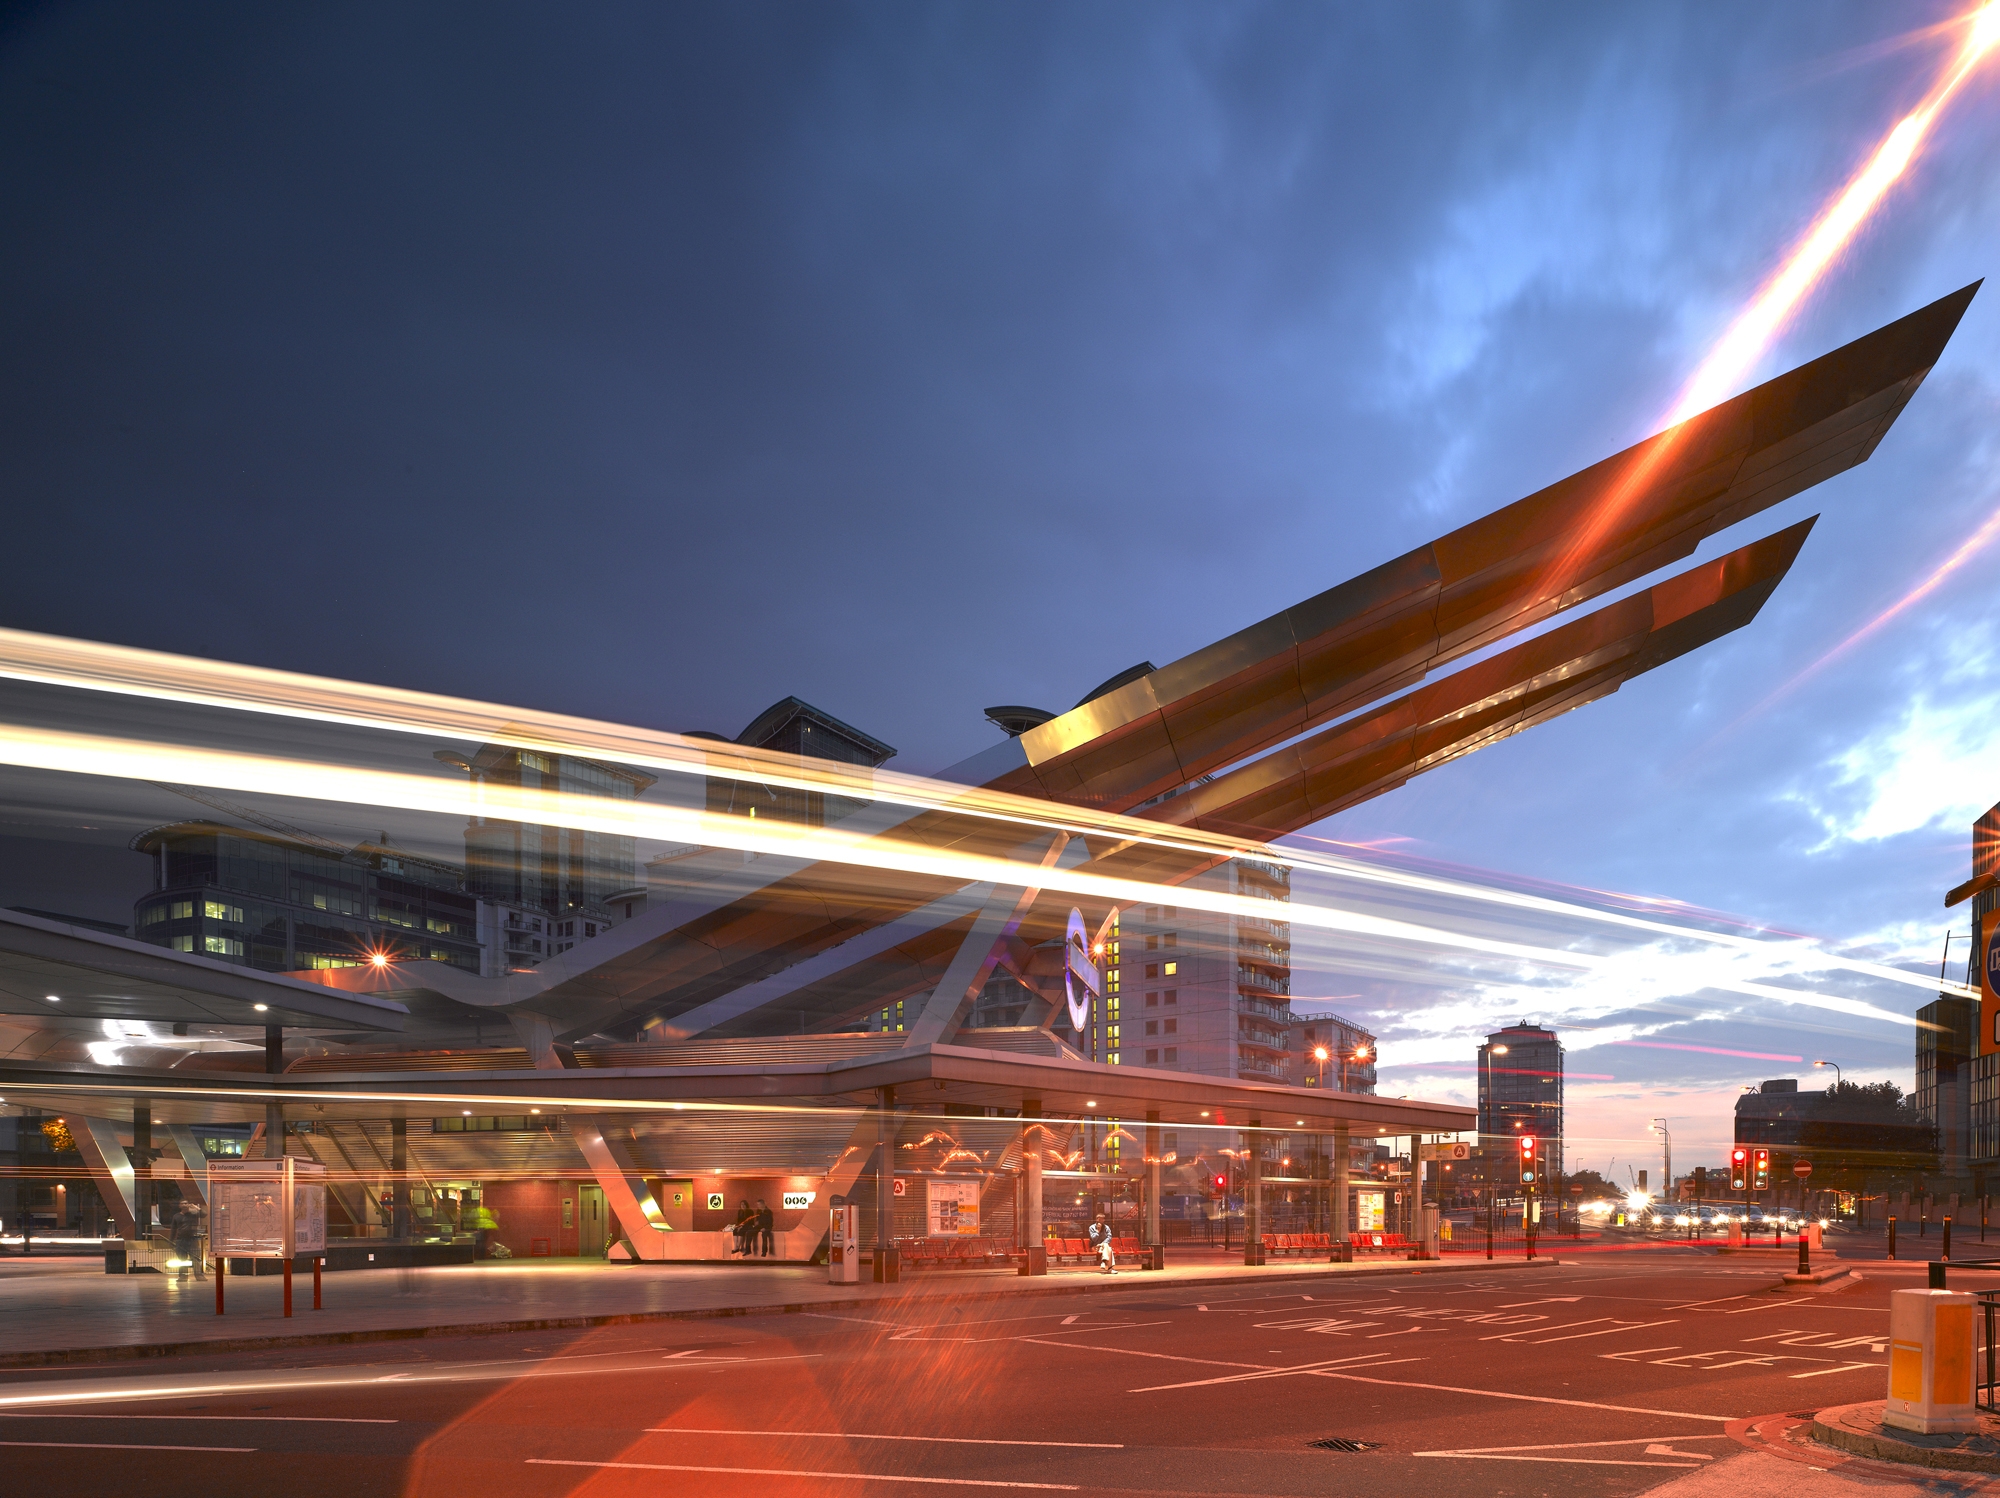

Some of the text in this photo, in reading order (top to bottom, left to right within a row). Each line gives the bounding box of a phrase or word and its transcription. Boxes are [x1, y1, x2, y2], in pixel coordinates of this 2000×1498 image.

[1456, 1147, 1463, 1156] A
[894, 1183, 901, 1192] A
[1339, 1306, 1550, 1325] AHEAD
[1252, 1317, 1449, 1339] ONLY
[1739, 1329, 1889, 1352] TUR
[1597, 1346, 1889, 1378] LEFT
